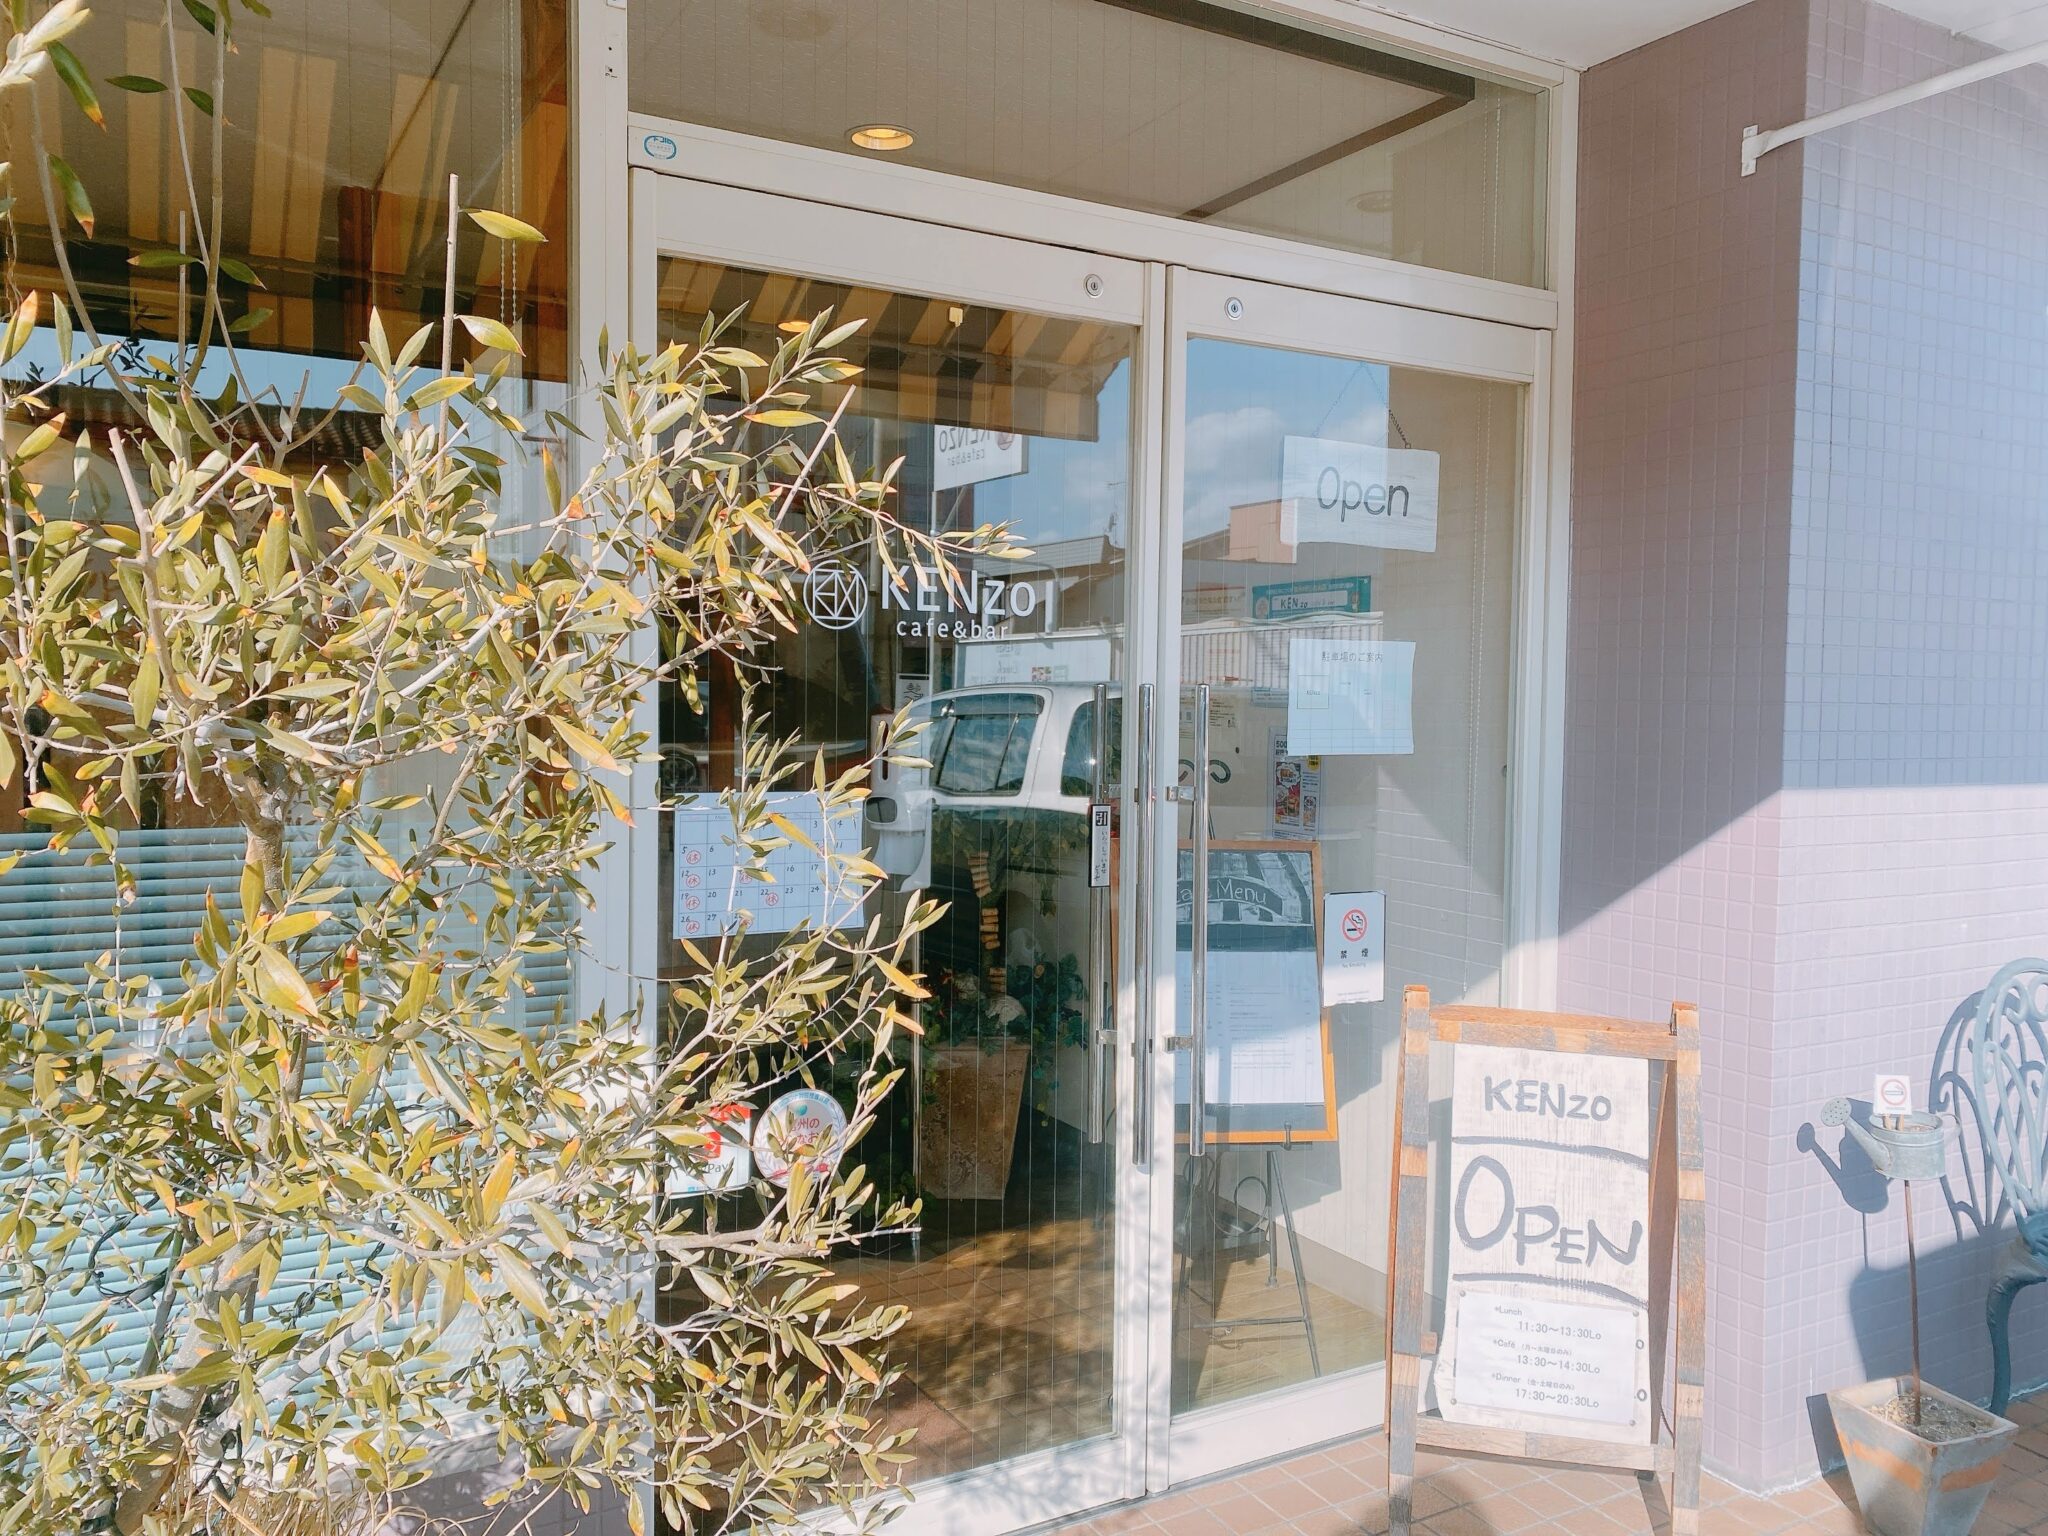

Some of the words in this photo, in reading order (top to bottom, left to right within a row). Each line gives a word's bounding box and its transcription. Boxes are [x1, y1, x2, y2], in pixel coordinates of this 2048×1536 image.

[1317, 466, 1409, 522] Open
[897, 617, 1009, 640] cafe&bar
[813, 820, 818, 828] 3
[709, 845, 714, 853] 6
[708, 868, 716, 876] 13
[1216, 878, 1267, 905] Menu
